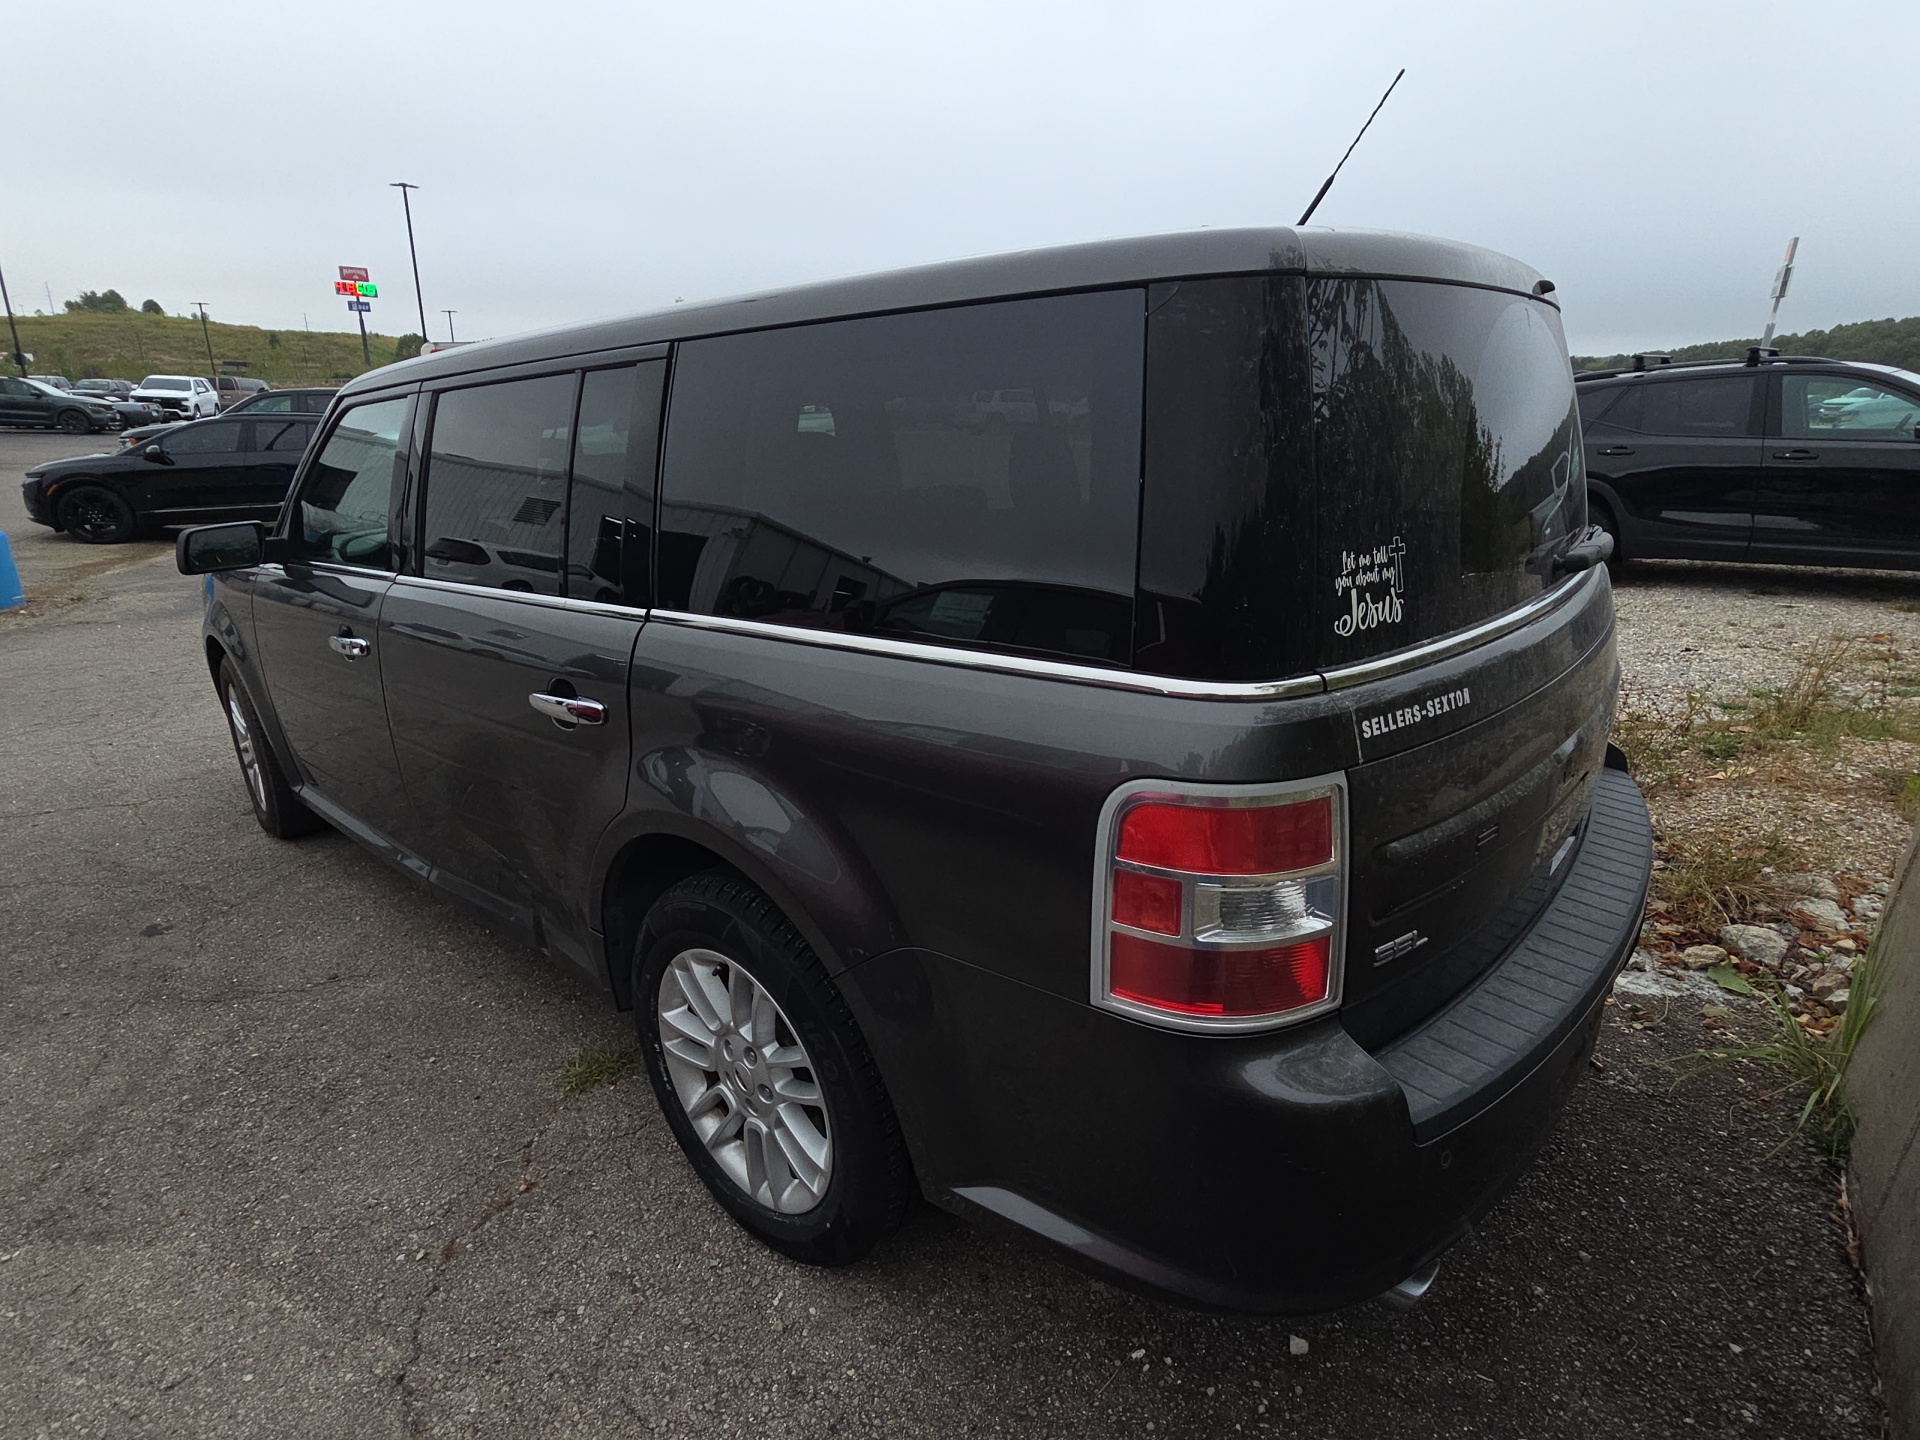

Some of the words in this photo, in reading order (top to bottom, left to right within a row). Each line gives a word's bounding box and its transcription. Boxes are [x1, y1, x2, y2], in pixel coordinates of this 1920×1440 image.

[1342, 550, 1356, 574] Let
[1359, 554, 1371, 567] me
[1373, 545, 1388, 564] tell
[1335, 575, 1353, 596] you
[1356, 565, 1380, 586] about
[1382, 566, 1395, 585] my
[1334, 587, 1404, 636] Jesus
[1361, 687, 1471, 738] SELLERS-SEXTON
[1373, 930, 1429, 968] SEL
